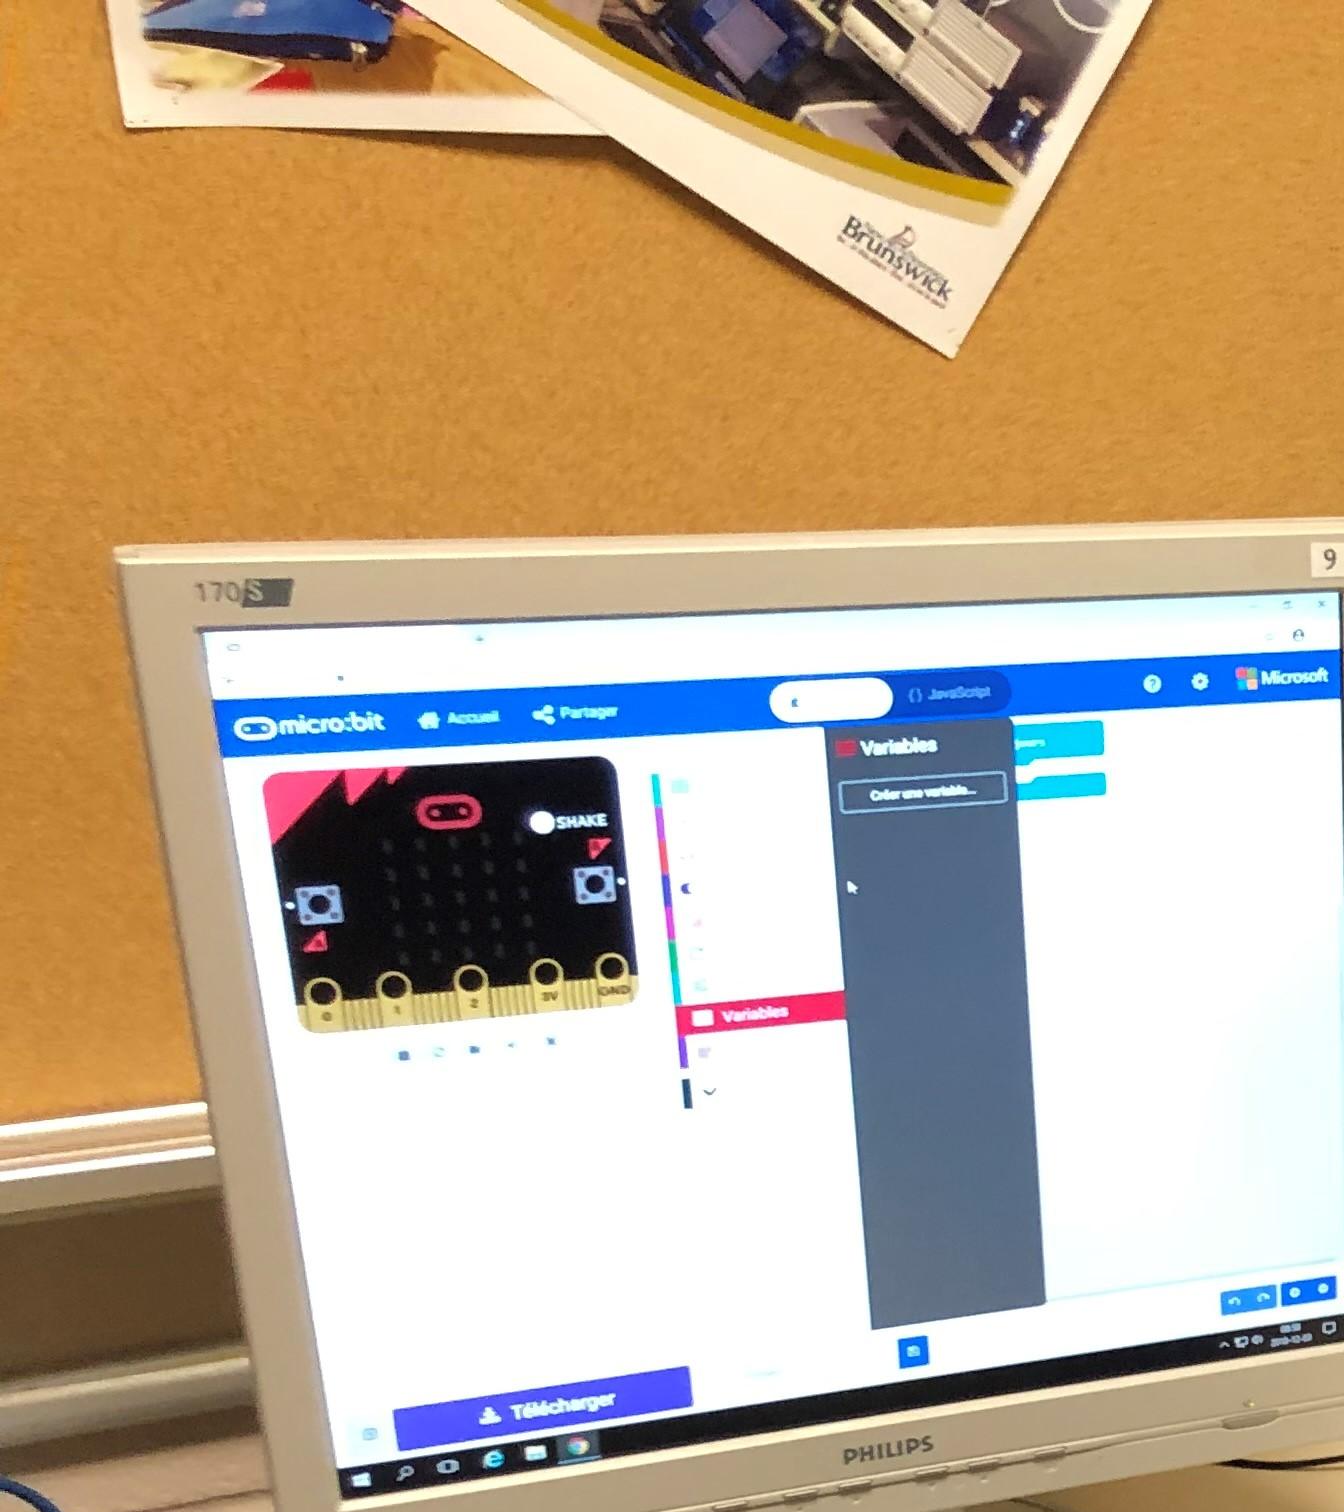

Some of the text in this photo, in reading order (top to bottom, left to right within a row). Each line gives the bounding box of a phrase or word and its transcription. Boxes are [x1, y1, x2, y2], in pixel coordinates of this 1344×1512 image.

[842, 215, 952, 302] Brunswick
[1323, 548, 1337, 571] 9
[194, 579, 264, 603] 170S
[1261, 666, 1329, 685] Microsoft
[928, 686, 991, 701] JavaScript
[447, 709, 500, 726] Accueil
[560, 705, 619, 721] Partager
[279, 711, 385, 736] micro:bit
[860, 736, 938, 757] Variables
[870, 786, 900, 802] Créer
[556, 812, 609, 830] SHAKE
[721, 1005, 790, 1023] Variables
[510, 1391, 616, 1421] Télécharger
[843, 1435, 935, 1466] PHILIPS
